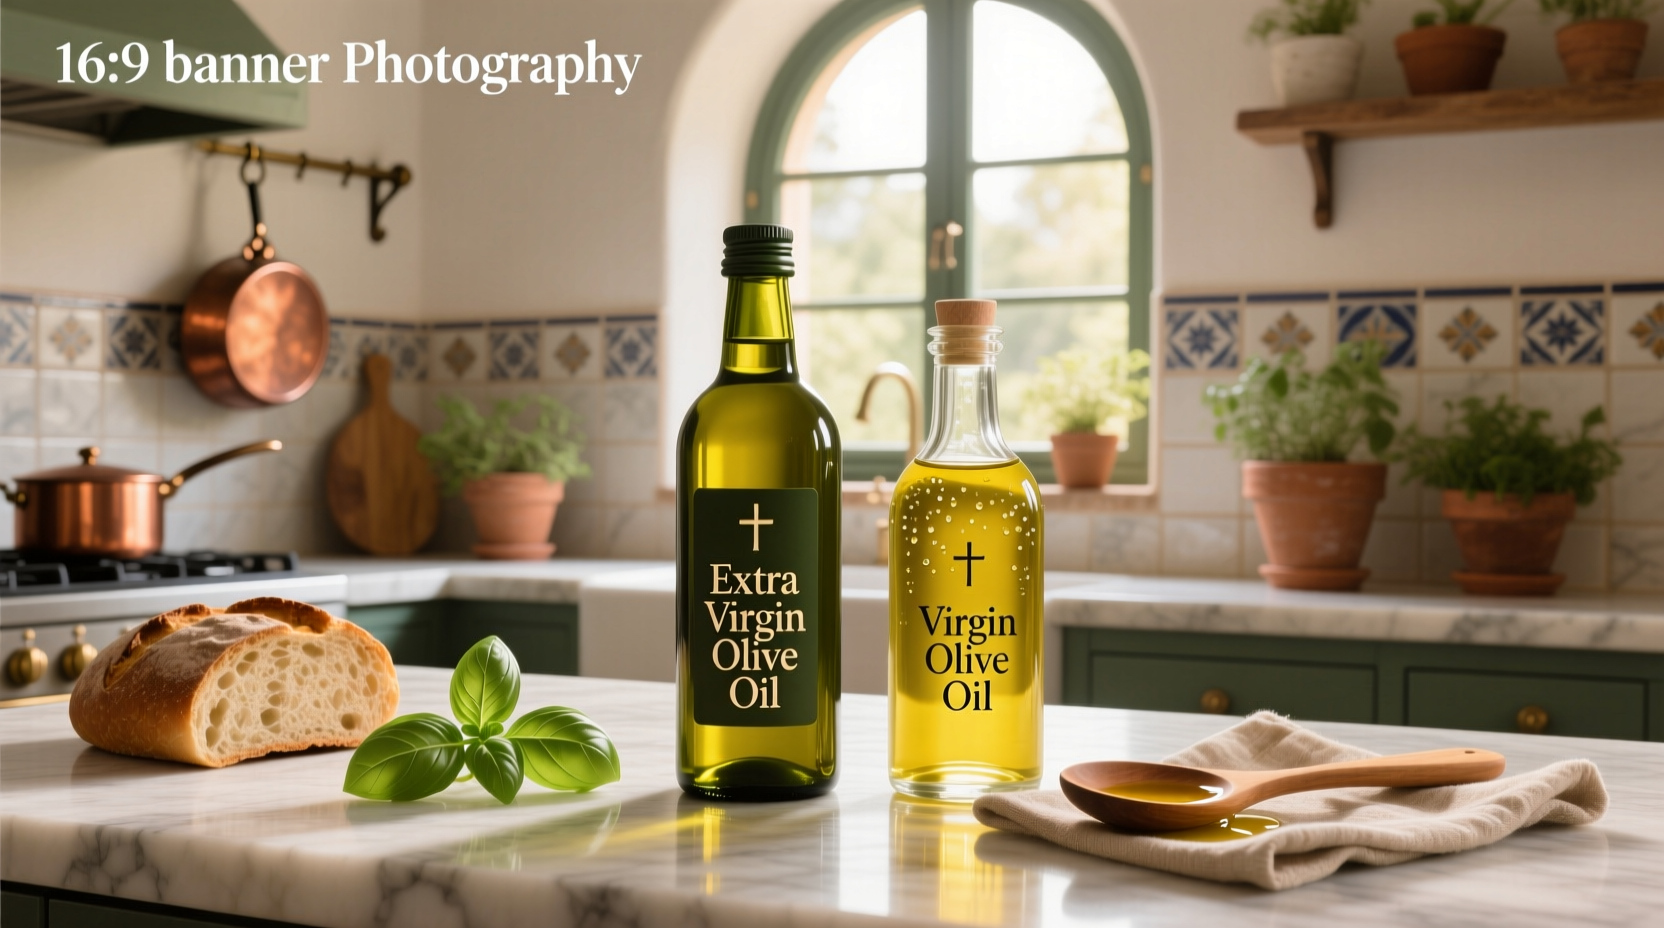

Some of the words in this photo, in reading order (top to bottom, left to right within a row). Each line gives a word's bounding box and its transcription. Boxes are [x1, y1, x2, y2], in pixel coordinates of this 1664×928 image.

[709, 563, 800, 595] Extra
[704, 601, 806, 643] Virgin
[917, 605, 1018, 645] Virgin
[711, 637, 799, 671] Olive
[925, 642, 1010, 675] Olive
[729, 676, 781, 709] Oil
[942, 680, 993, 711] Oil
